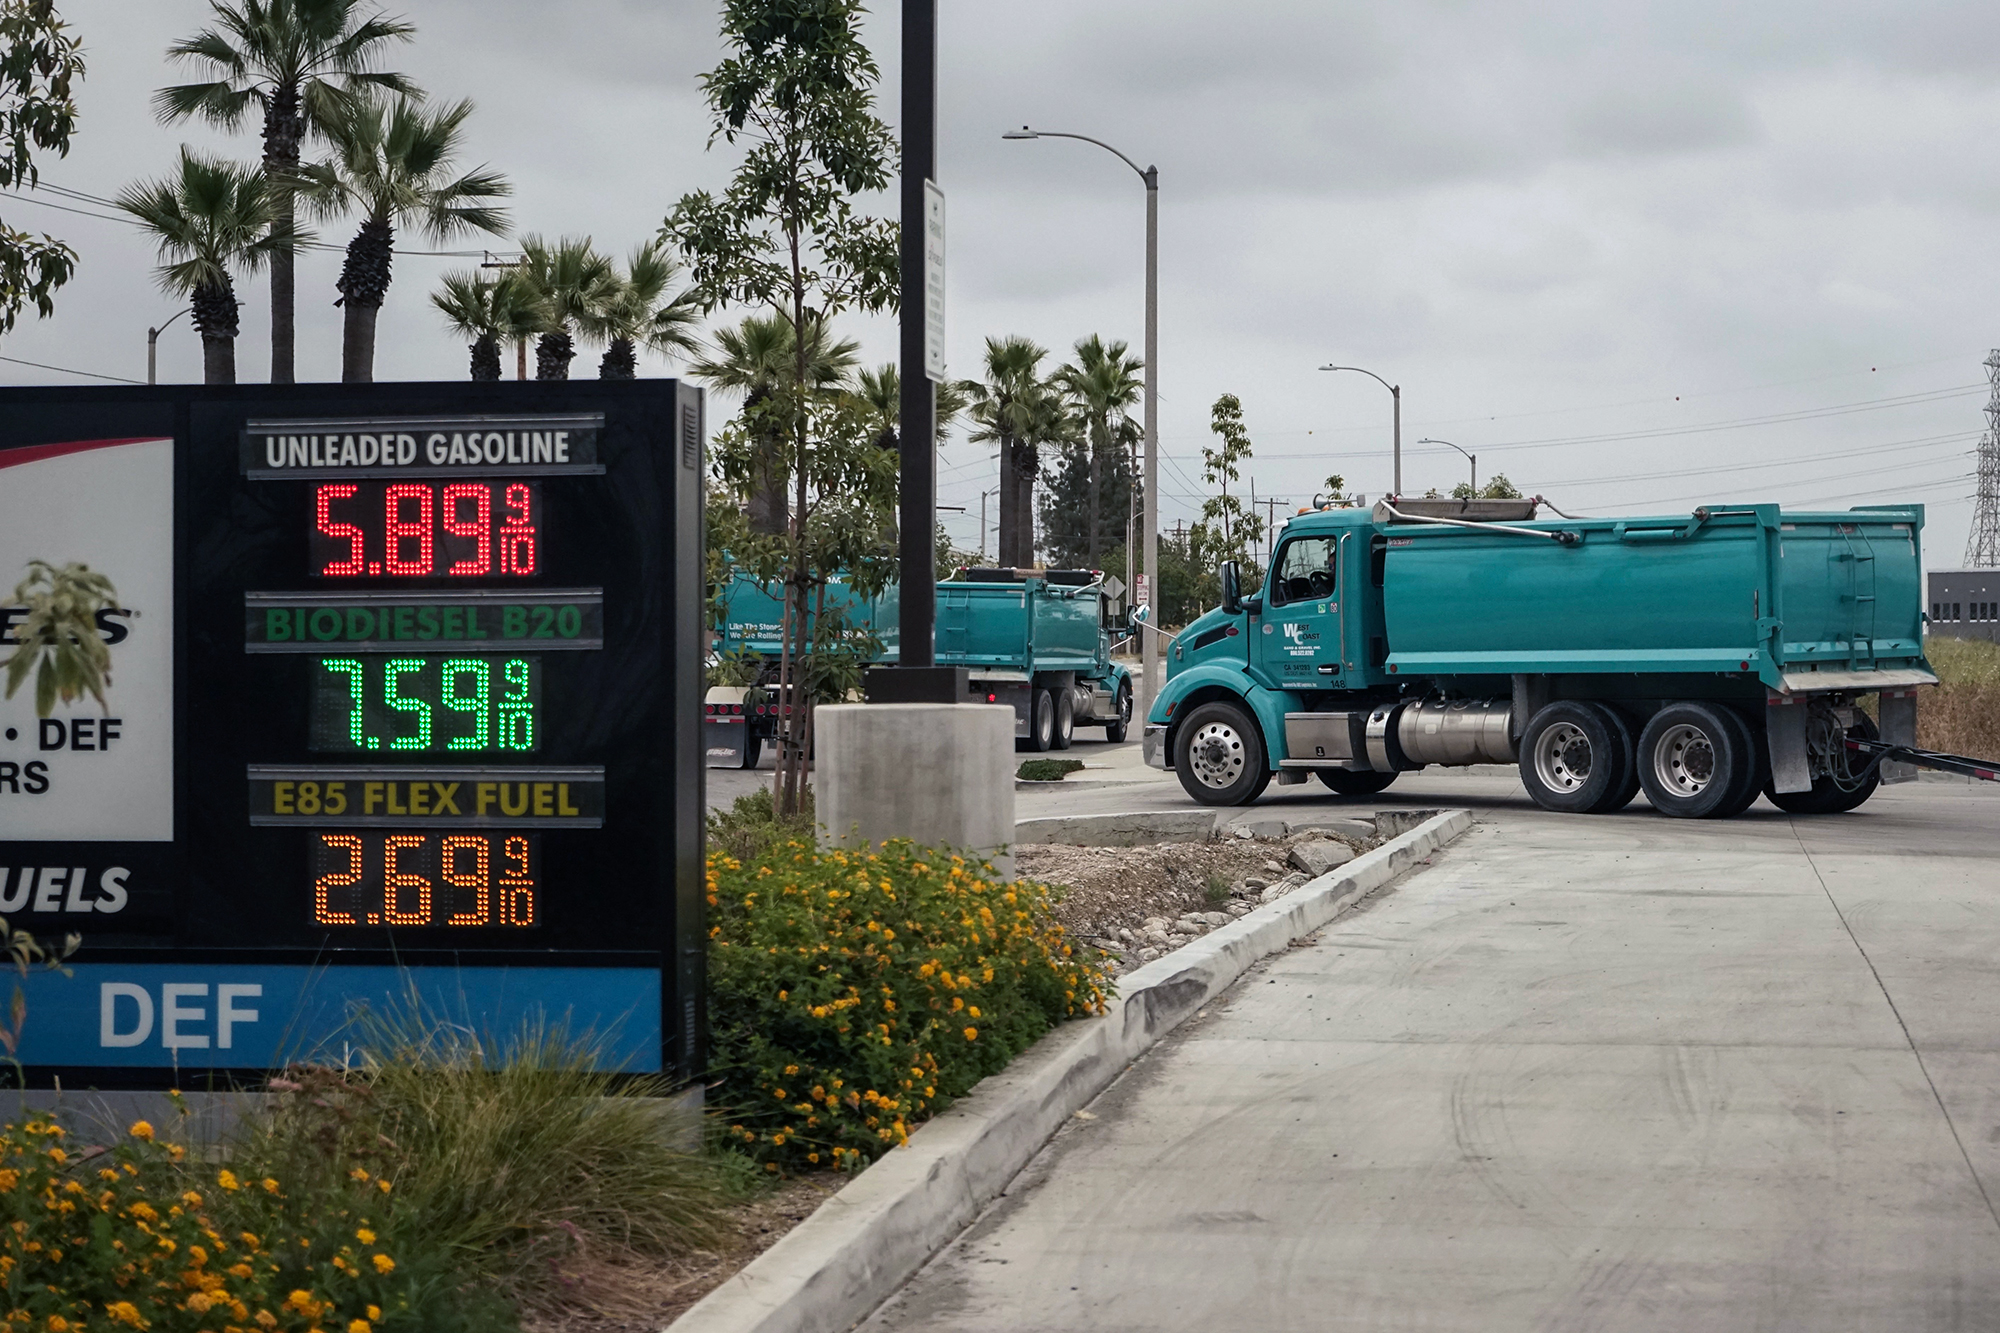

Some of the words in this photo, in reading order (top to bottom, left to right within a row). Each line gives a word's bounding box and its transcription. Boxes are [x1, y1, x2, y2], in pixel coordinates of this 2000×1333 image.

[266, 433, 417, 468] UNLEADED
[426, 430, 570, 466] GASOLINE
[316, 483, 492, 577] 5.89
[266, 606, 487, 642] BIODIESEL
[502, 603, 583, 639] B20
[728, 622, 743, 630] Like
[744, 622, 757, 630] The
[1330, 680, 1346, 689] 148
[320, 658, 490, 752] 7.59
[38, 718, 123, 752] DEF
[275, 782, 346, 815] E85
[364, 782, 460, 815] FLEX
[476, 782, 579, 817] FUEL
[315, 833, 490, 926] 2.69
[100, 982, 263, 1050] DEF
